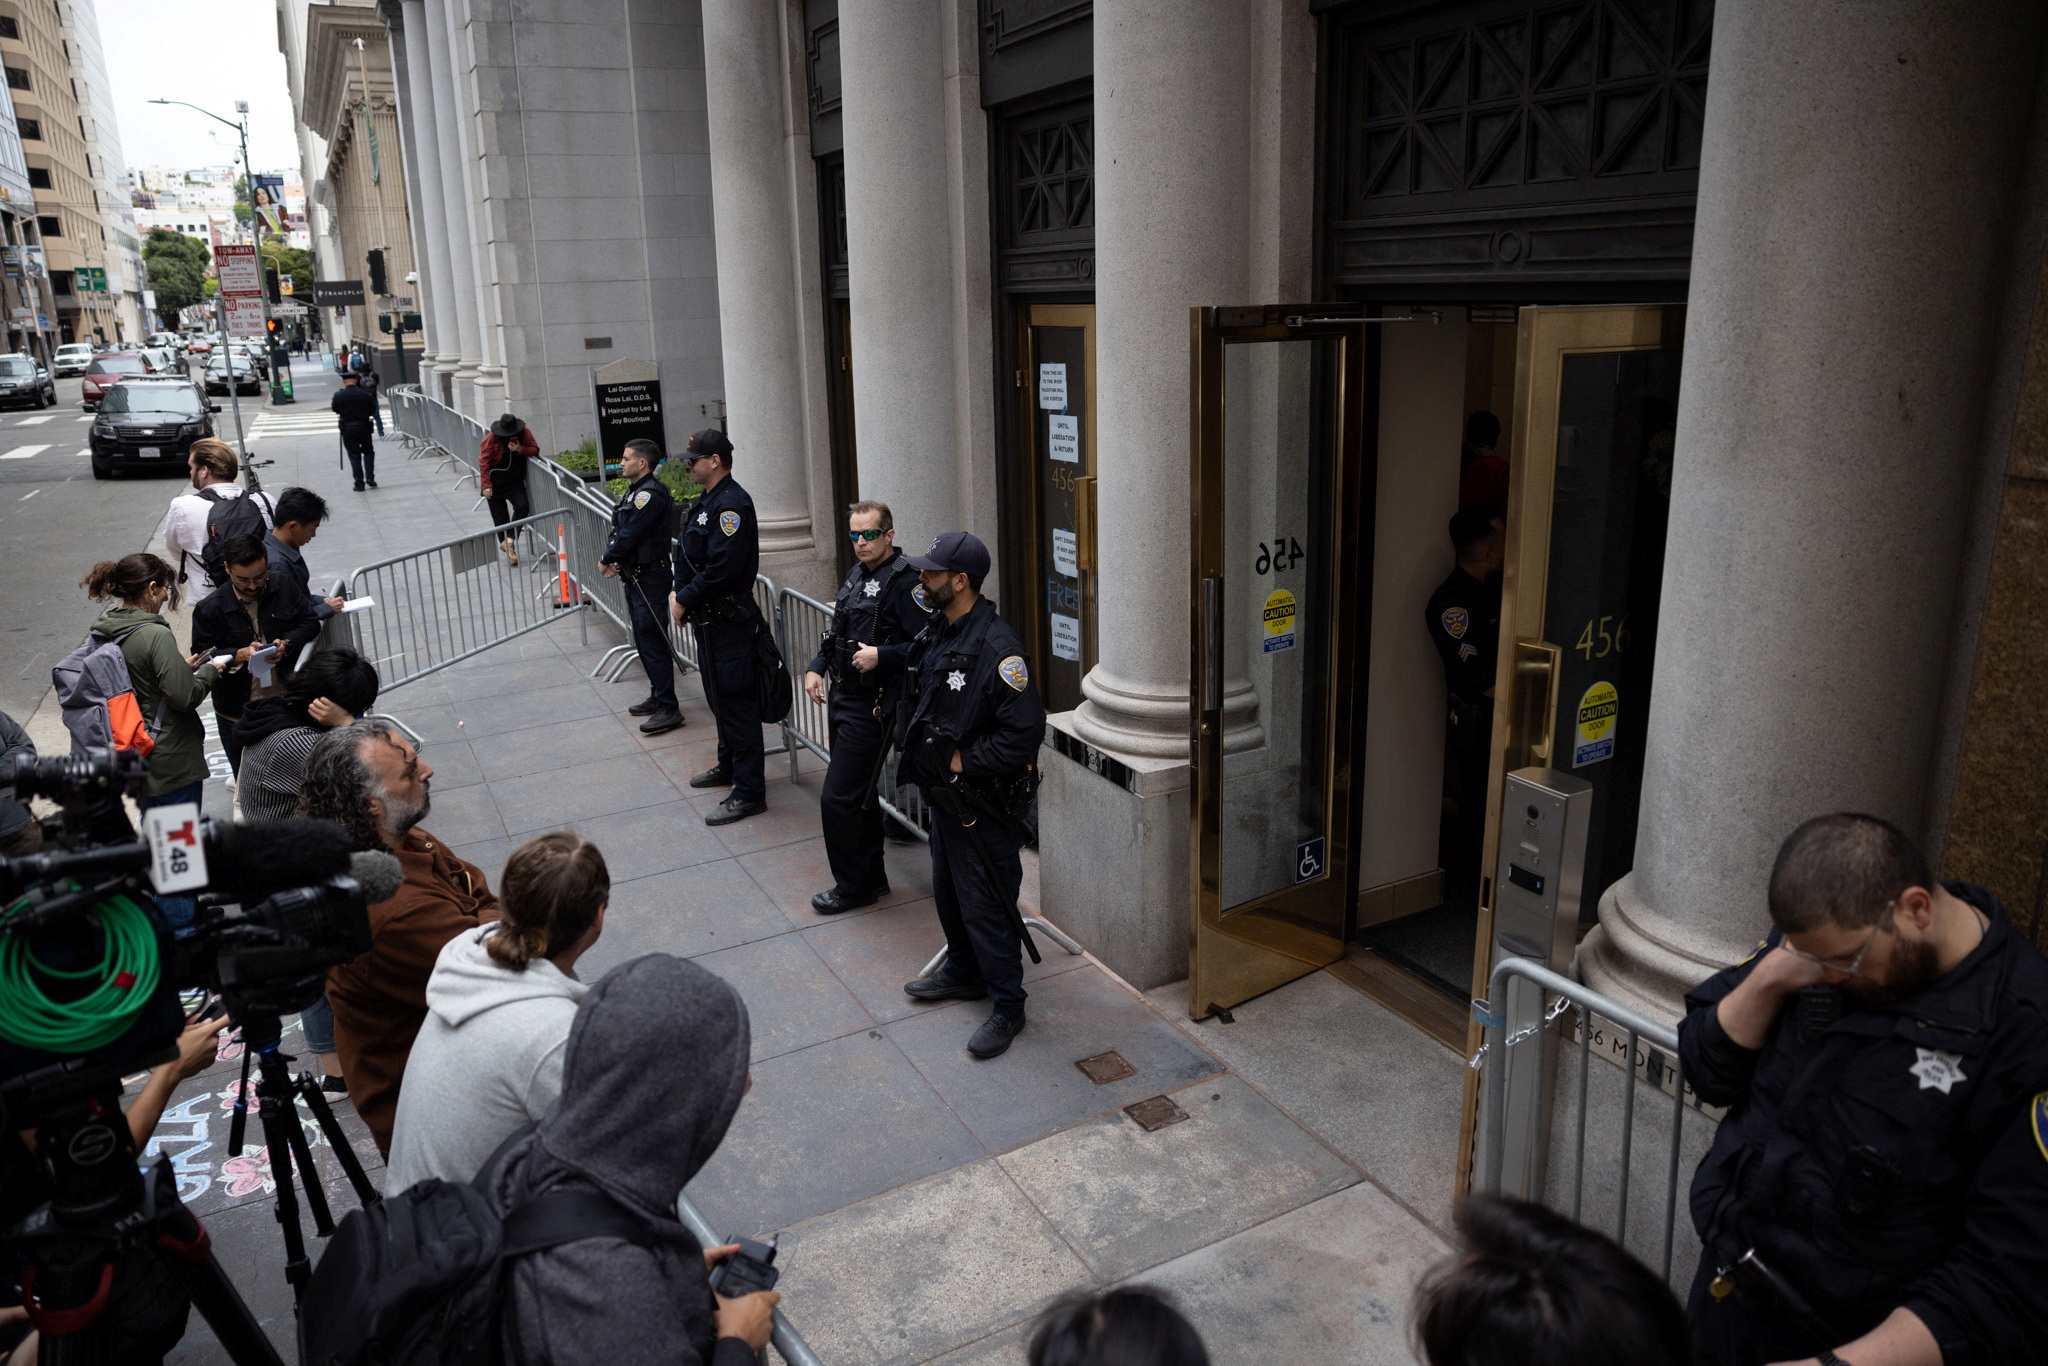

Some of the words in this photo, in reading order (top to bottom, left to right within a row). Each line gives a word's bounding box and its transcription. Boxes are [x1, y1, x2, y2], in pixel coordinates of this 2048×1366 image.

[217, 246, 253, 255] TOW-AWAY
[217, 255, 229, 266] NO
[230, 257, 254, 265] STOPPING
[225, 300, 236, 310] NO
[238, 302, 261, 310] PARKING
[1052, 434, 1075, 442] LIBERATION
[1051, 467, 1075, 492] 456
[1048, 577, 1079, 613] FREE
[1266, 596, 1293, 608] AUTOMATIC
[1264, 605, 1295, 620] CAUTION
[1058, 622, 1071, 631] UNTIL
[1272, 619, 1286, 628] DOOR
[1054, 632, 1077, 643] LIBERATION
[1575, 615, 1630, 661] 456
[1060, 644, 1076, 653] RETURN
[1584, 690, 1615, 705] AUTOMATIC
[1580, 702, 1616, 721] CAUTION
[1588, 720, 1605, 731] DOOR
[1588, 749, 1606, 760] OPERATE
[170, 847, 189, 874] 48
